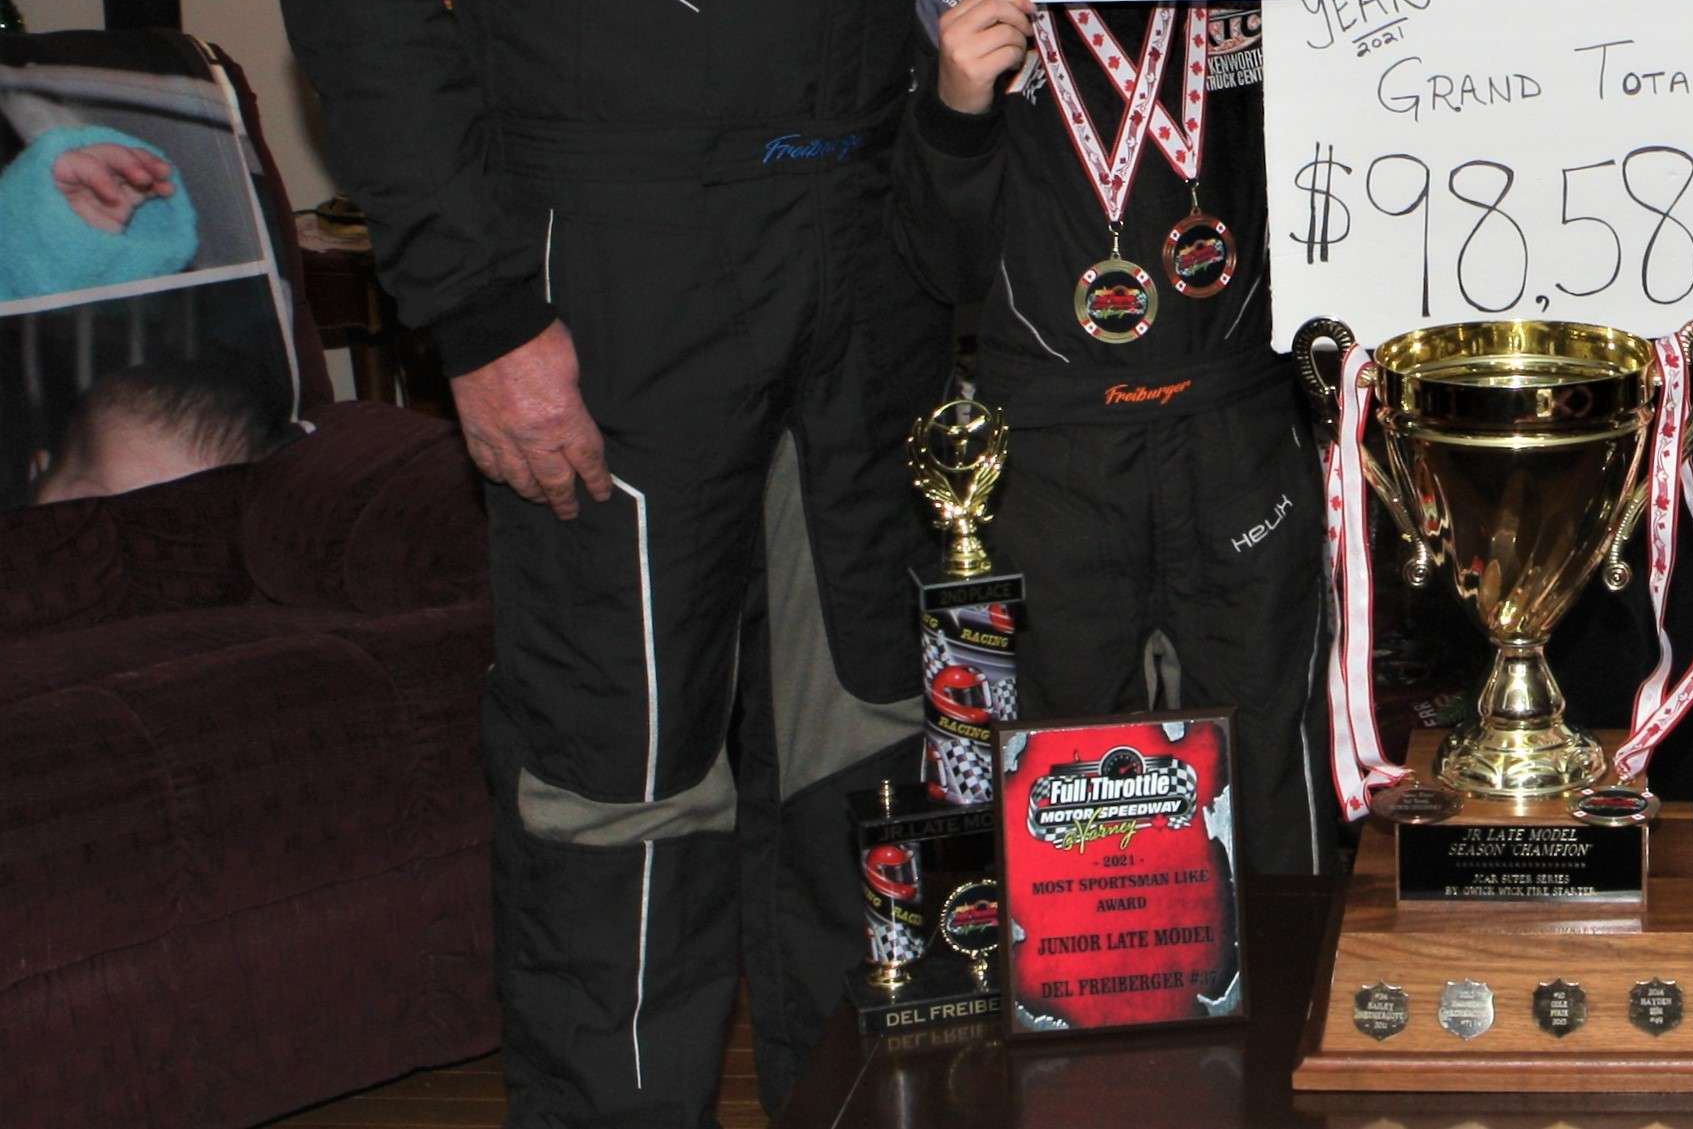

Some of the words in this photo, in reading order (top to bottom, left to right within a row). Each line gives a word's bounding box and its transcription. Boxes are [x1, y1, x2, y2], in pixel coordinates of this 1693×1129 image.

[1356, 26, 1406, 58] 2021
[1377, 57, 1543, 121] GRAND
[960, 628, 1009, 648] RACING
[939, 716, 991, 741] RACING
[1050, 776, 1088, 804] Full
[1090, 771, 1171, 802] Throttle
[1040, 807, 1093, 825] MOTOR
[1098, 799, 1182, 820] SPEEDWAY
[1462, 829, 1481, 841] JR
[1486, 829, 1524, 841] LATE
[1529, 829, 1577, 841] MODEL
[1103, 854, 1135, 868] 2021
[1449, 843, 1505, 856] SEASON
[1032, 879, 1074, 896] MOST
[1079, 871, 1170, 892] SPORTSMAN
[1174, 869, 1209, 885] LIKE
[1096, 896, 1147, 913] AWARD
[1038, 933, 1102, 956] JUNIOR
[1107, 929, 1149, 951] LATE
[1154, 925, 1215, 947] MODEL
[1042, 980, 1073, 999] DEL
[1079, 971, 1185, 996] FREIBERGER
[886, 1009, 926, 1027] DEL
[929, 998, 999, 1021] FREIBE
